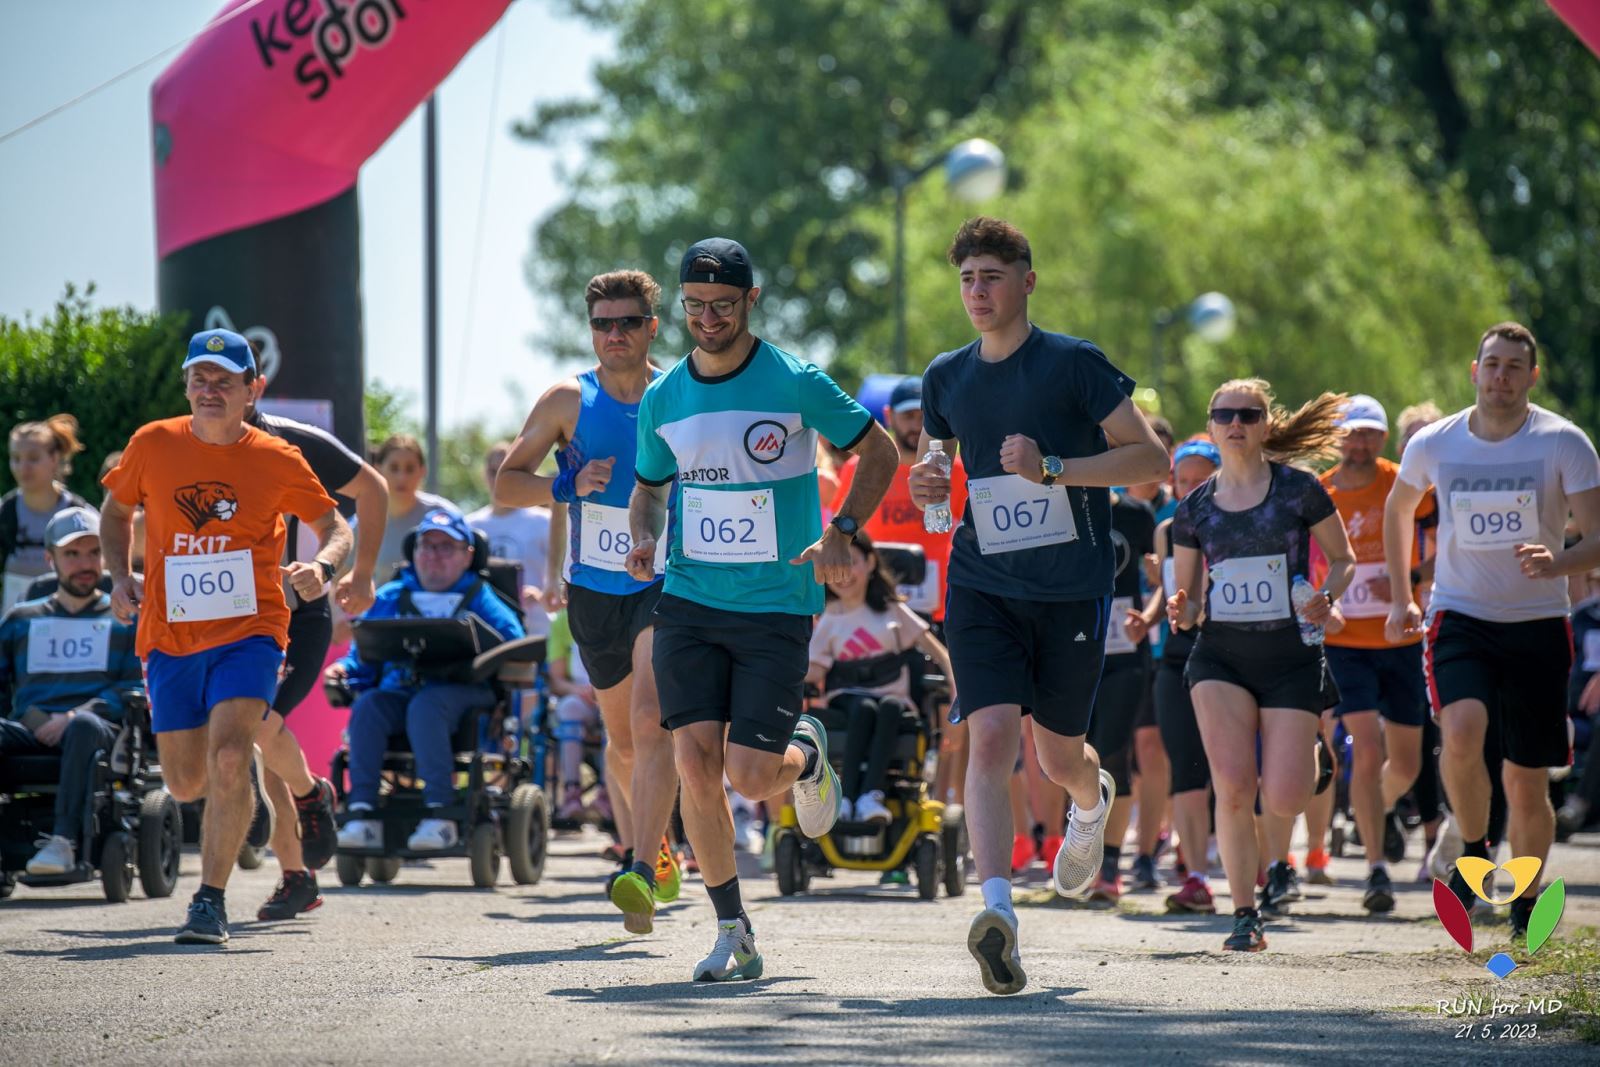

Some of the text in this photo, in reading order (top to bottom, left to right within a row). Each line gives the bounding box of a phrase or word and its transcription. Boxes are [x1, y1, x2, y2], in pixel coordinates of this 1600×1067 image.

[992, 498, 1050, 532] 067
[1470, 511, 1522, 535] 098
[598, 529, 631, 554] 08
[700, 517, 757, 544] 062
[172, 532, 232, 555] FKIT
[1222, 580, 1272, 605] 010
[1343, 583, 1369, 604] 10
[47, 637, 93, 659] 105
